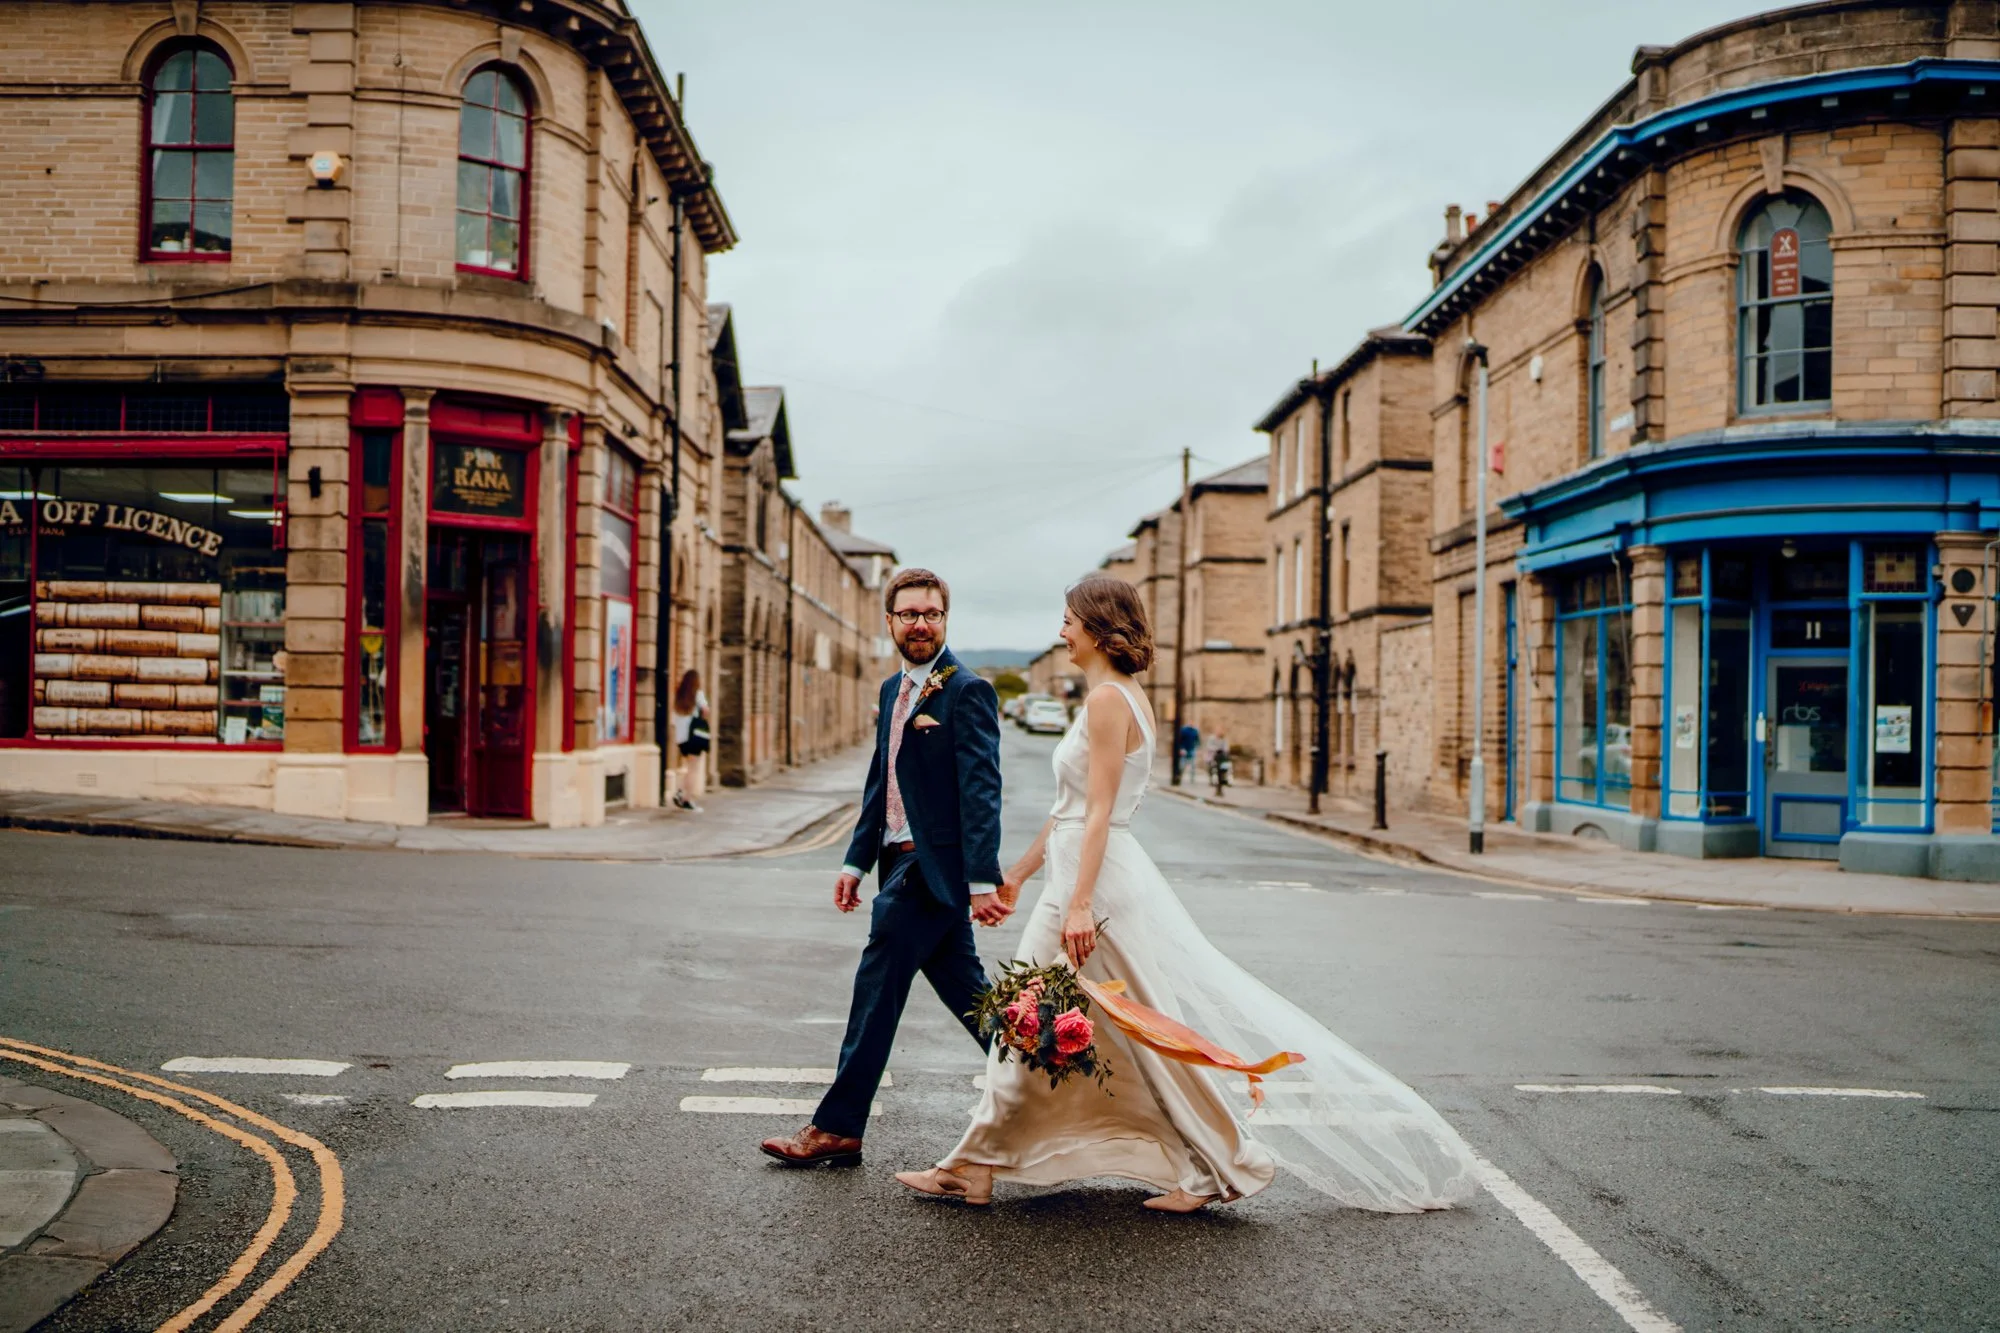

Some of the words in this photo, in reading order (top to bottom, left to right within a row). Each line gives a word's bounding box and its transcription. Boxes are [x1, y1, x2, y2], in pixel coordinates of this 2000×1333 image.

[454, 467, 511, 491] RANA
[43, 500, 100, 525] OFF
[103, 504, 223, 557] LICENCE
